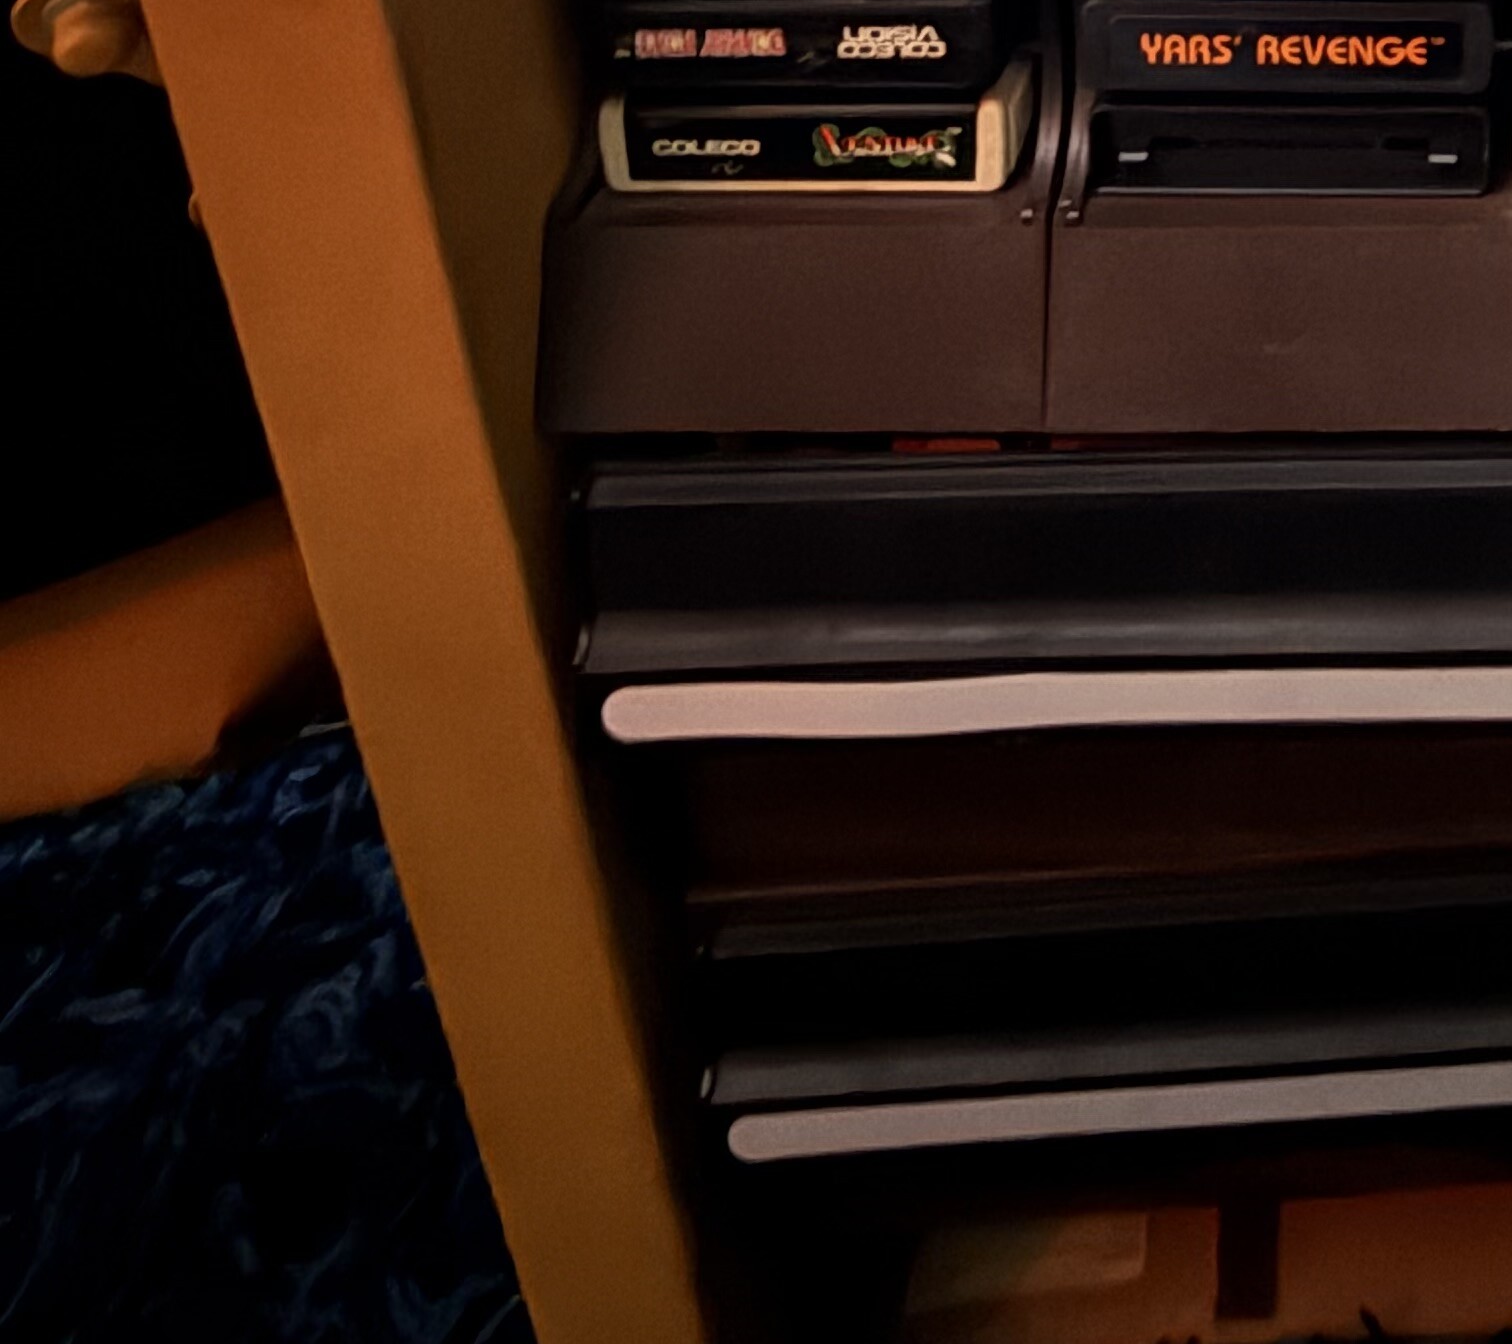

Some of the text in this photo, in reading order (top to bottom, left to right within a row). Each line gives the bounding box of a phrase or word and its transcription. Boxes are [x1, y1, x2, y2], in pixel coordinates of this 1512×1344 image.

[837, 42, 946, 59] COLECO
[1256, 34, 1428, 66] REVENGE
[652, 140, 760, 156] COLECO
